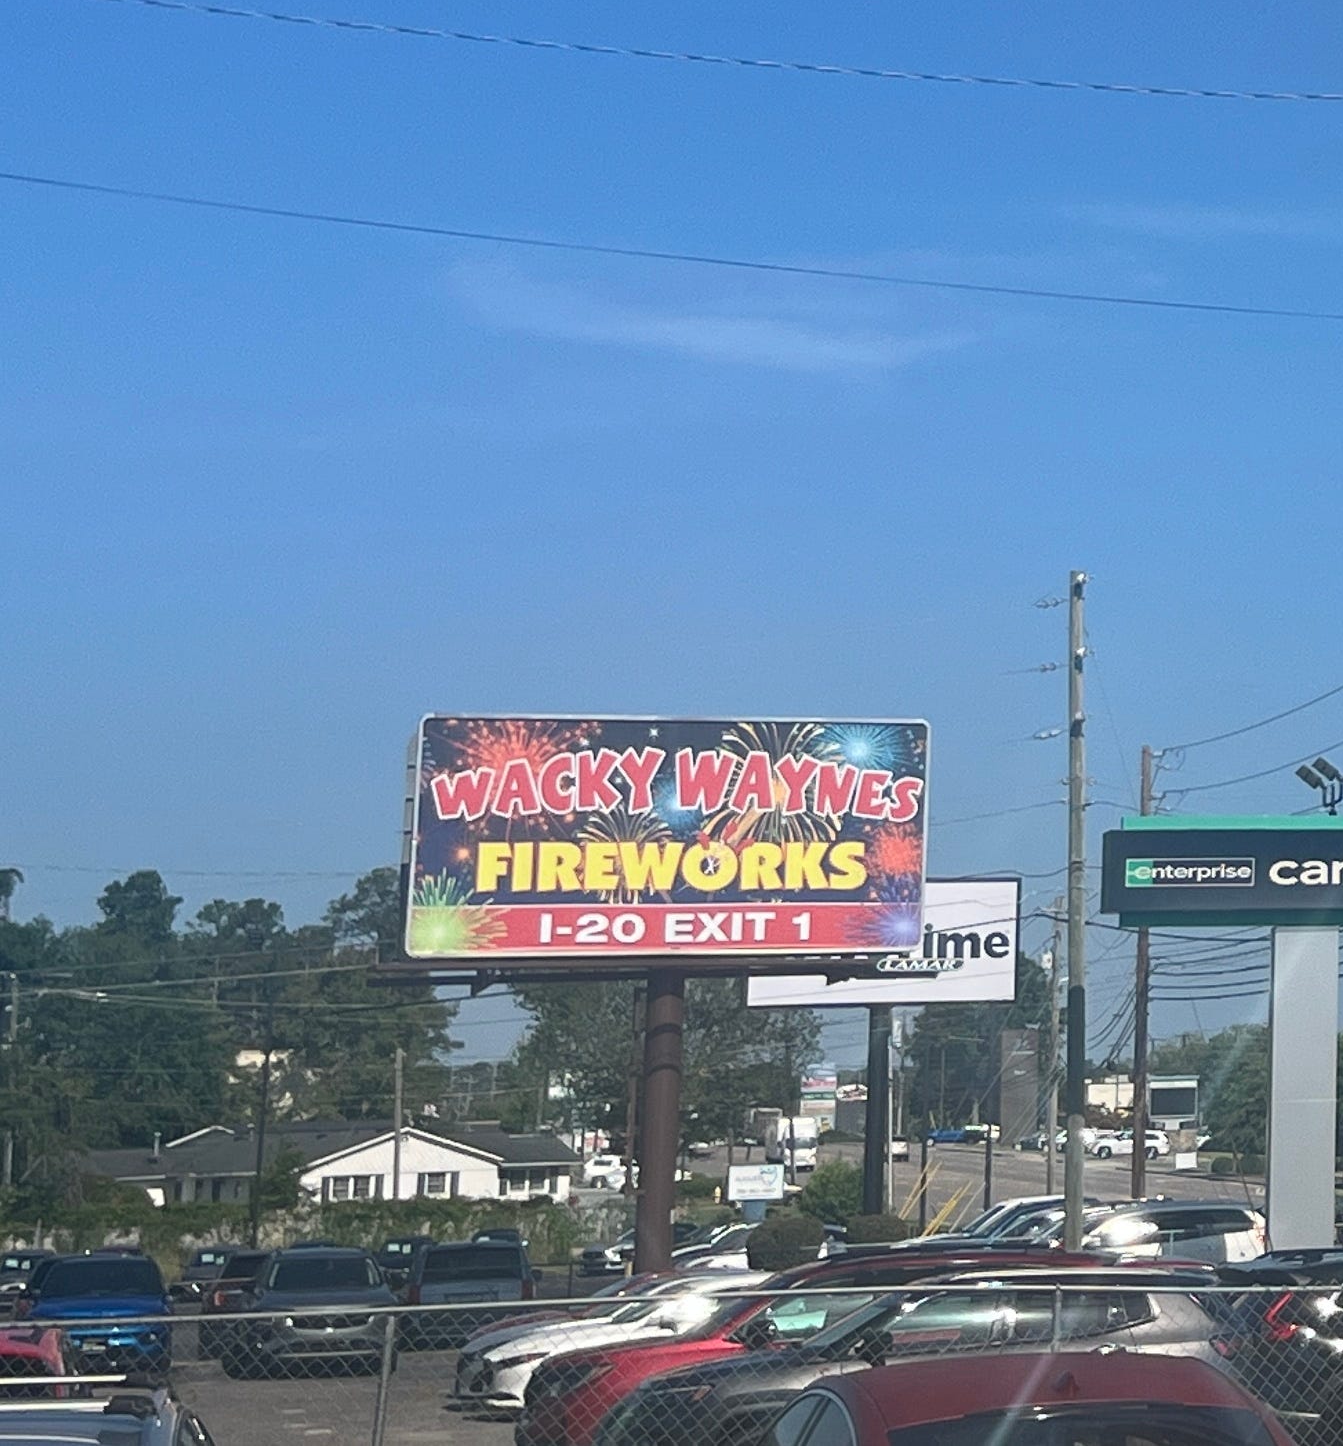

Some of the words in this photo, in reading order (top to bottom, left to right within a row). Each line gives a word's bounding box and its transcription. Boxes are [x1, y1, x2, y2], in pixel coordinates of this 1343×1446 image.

[431, 747, 665, 821] WACKY
[675, 748, 923, 822] WAYNES
[475, 840, 868, 894] FIREWORKS
[1133, 863, 1252, 883] enterprise
[539, 912, 646, 944] I-20
[664, 911, 776, 943] EXIT
[792, 912, 811, 941] 1
[883, 959, 960, 971] LAMAR
